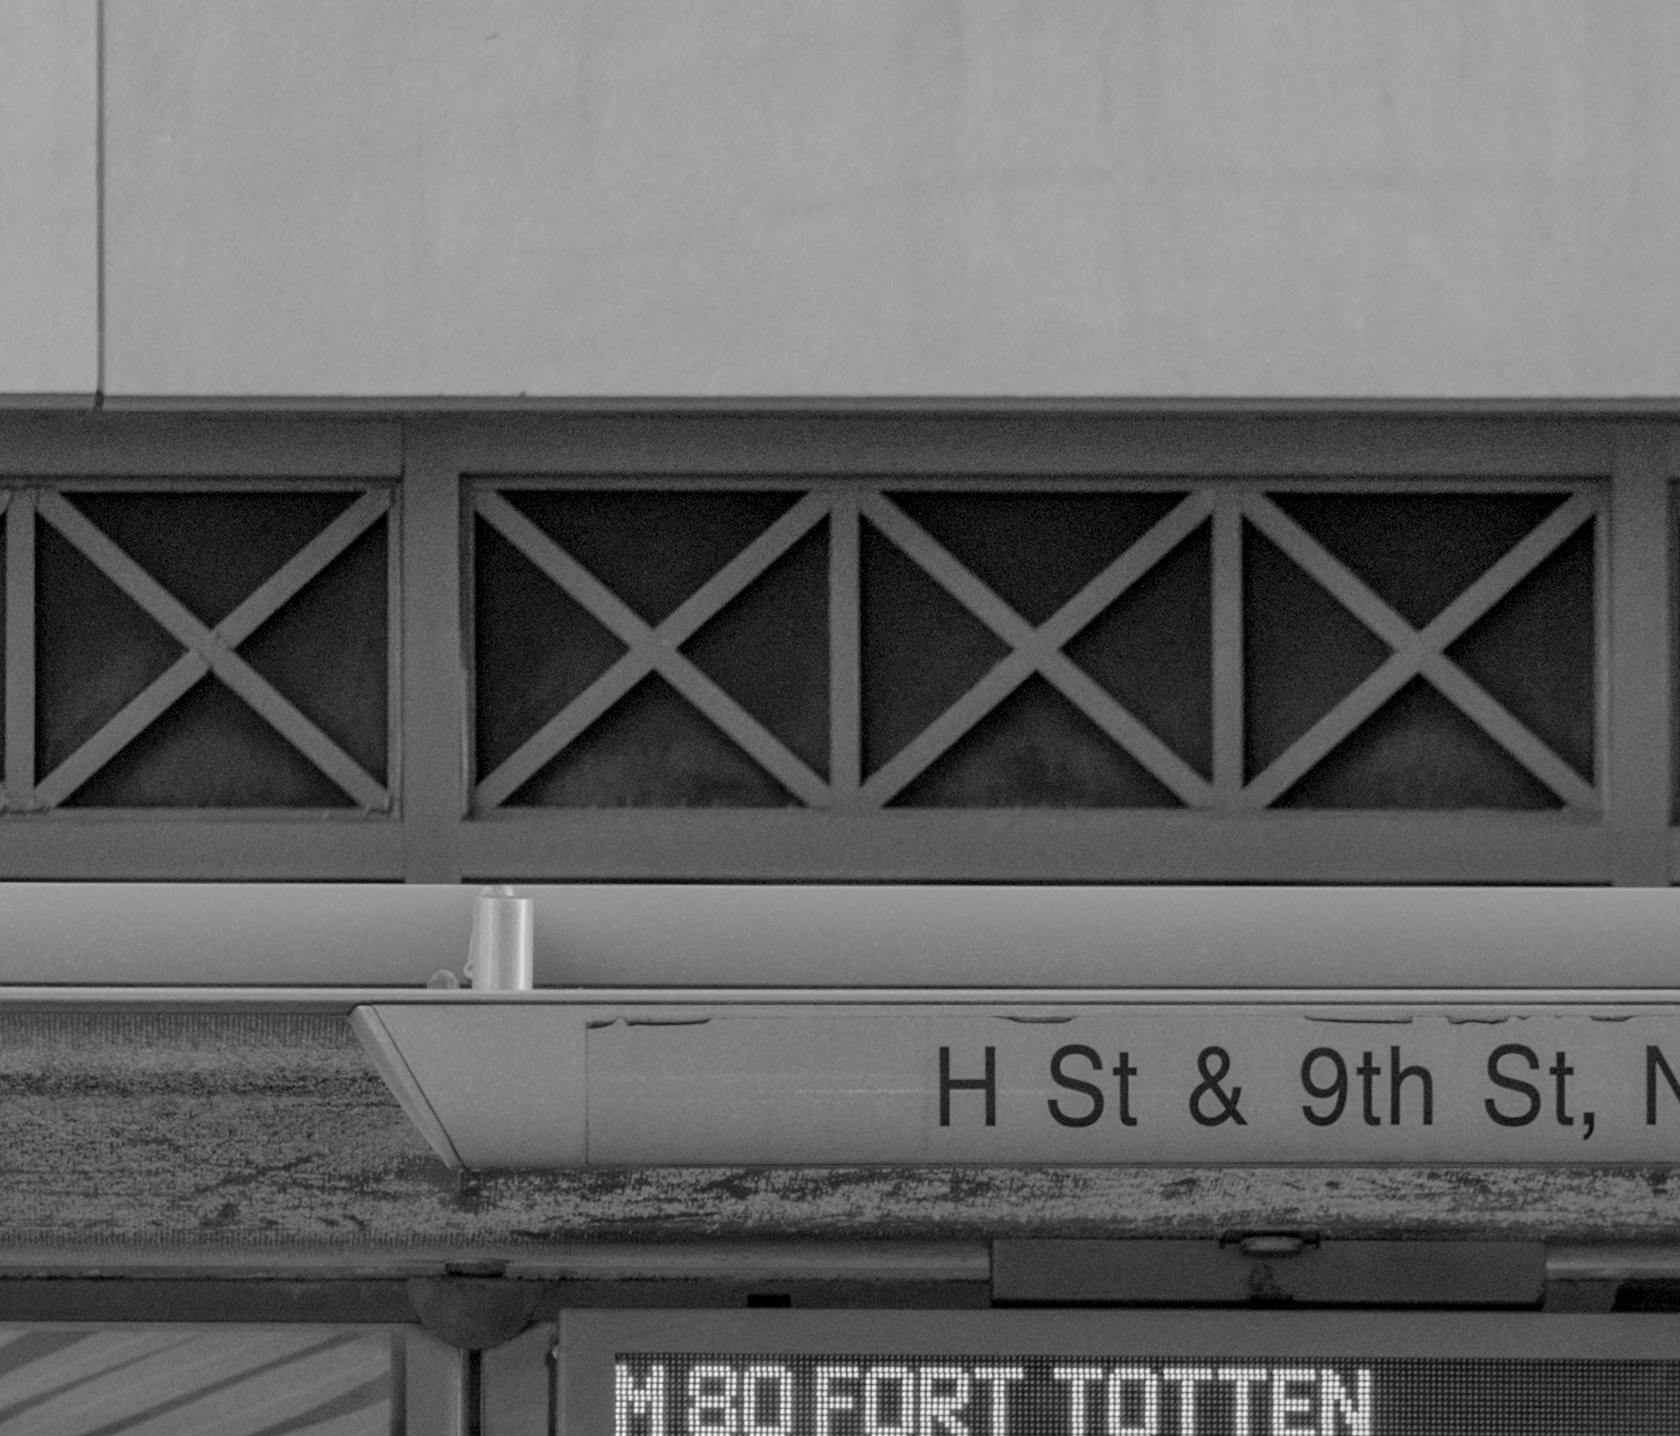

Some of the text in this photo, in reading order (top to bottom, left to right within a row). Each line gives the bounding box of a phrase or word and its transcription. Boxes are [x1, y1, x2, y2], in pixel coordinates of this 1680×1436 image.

[939, 1046, 997, 1128] H
[1047, 1043, 1138, 1130] St
[1188, 1043, 1249, 1130] &
[1300, 1043, 1434, 1130] 9th
[1484, 1043, 1596, 1142] St,
